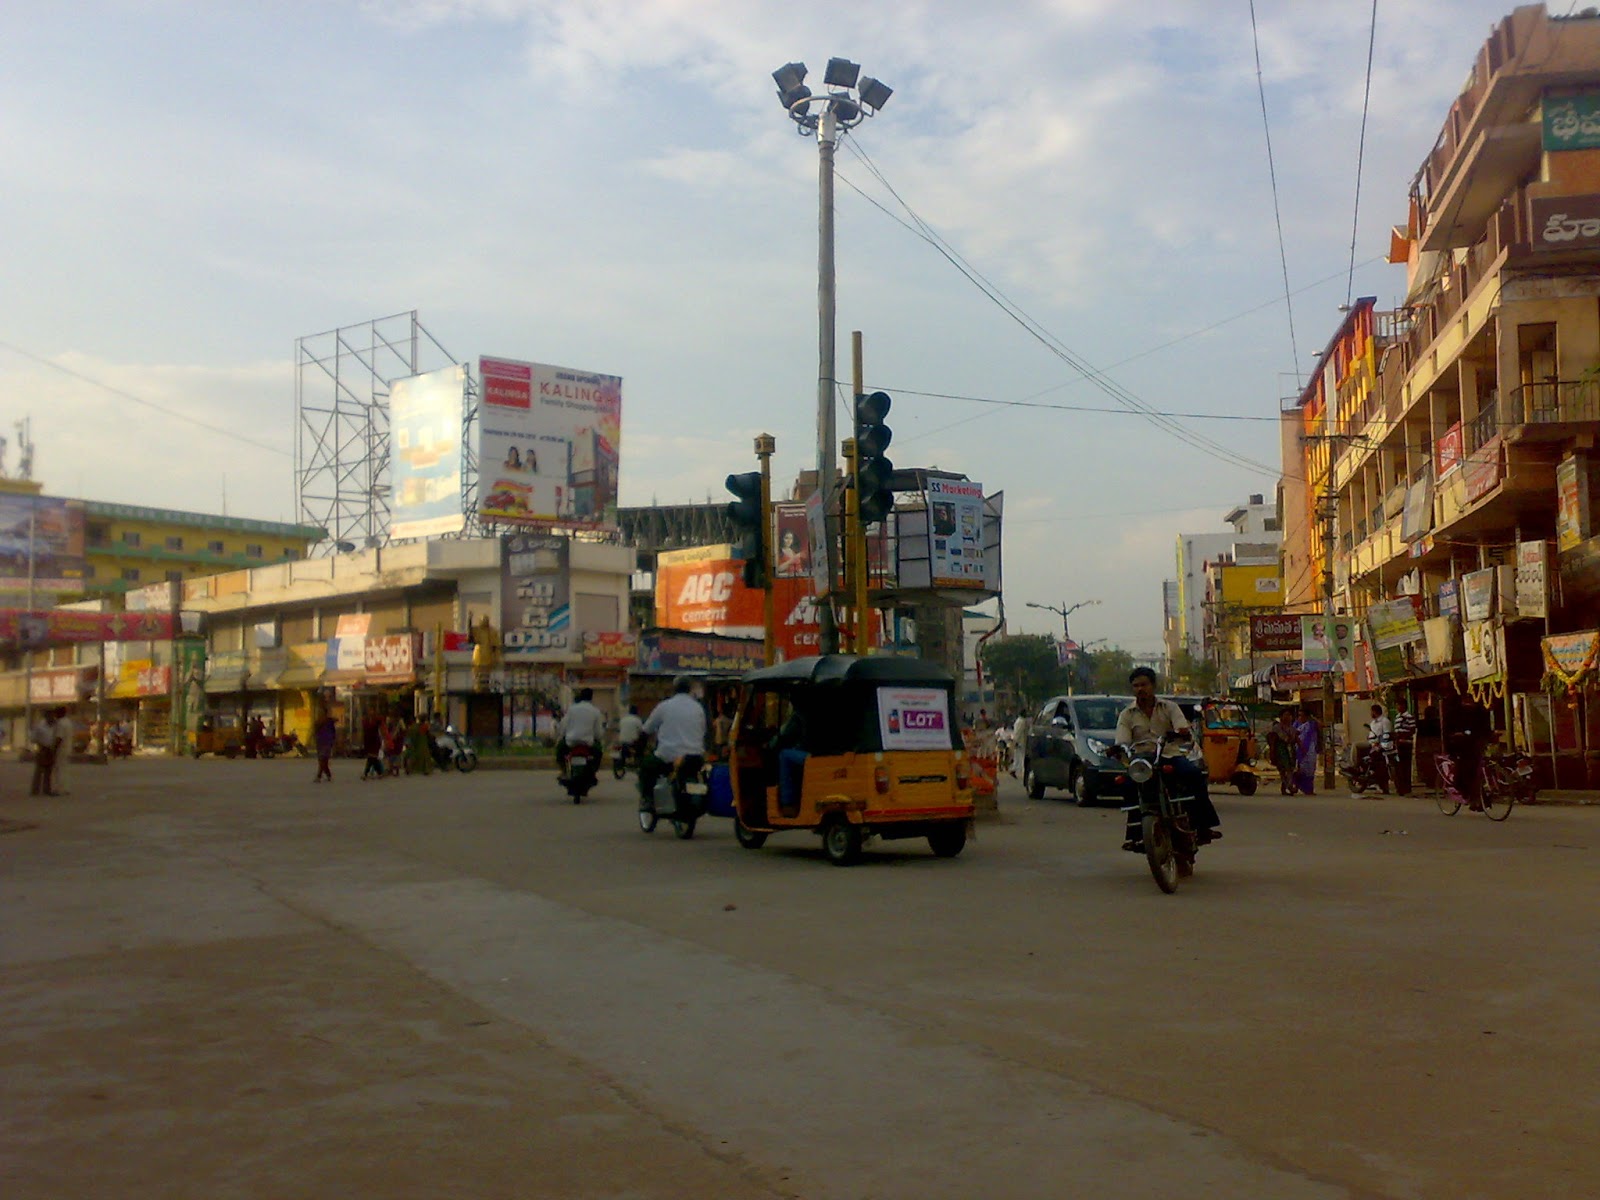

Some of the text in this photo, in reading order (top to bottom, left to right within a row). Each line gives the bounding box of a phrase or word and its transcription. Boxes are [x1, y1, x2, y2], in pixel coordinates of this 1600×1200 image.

[931, 482, 982, 498] SS Marketing
[677, 572, 734, 606] ACC
[681, 606, 727, 623] cement
[906, 713, 936, 726] LOT
